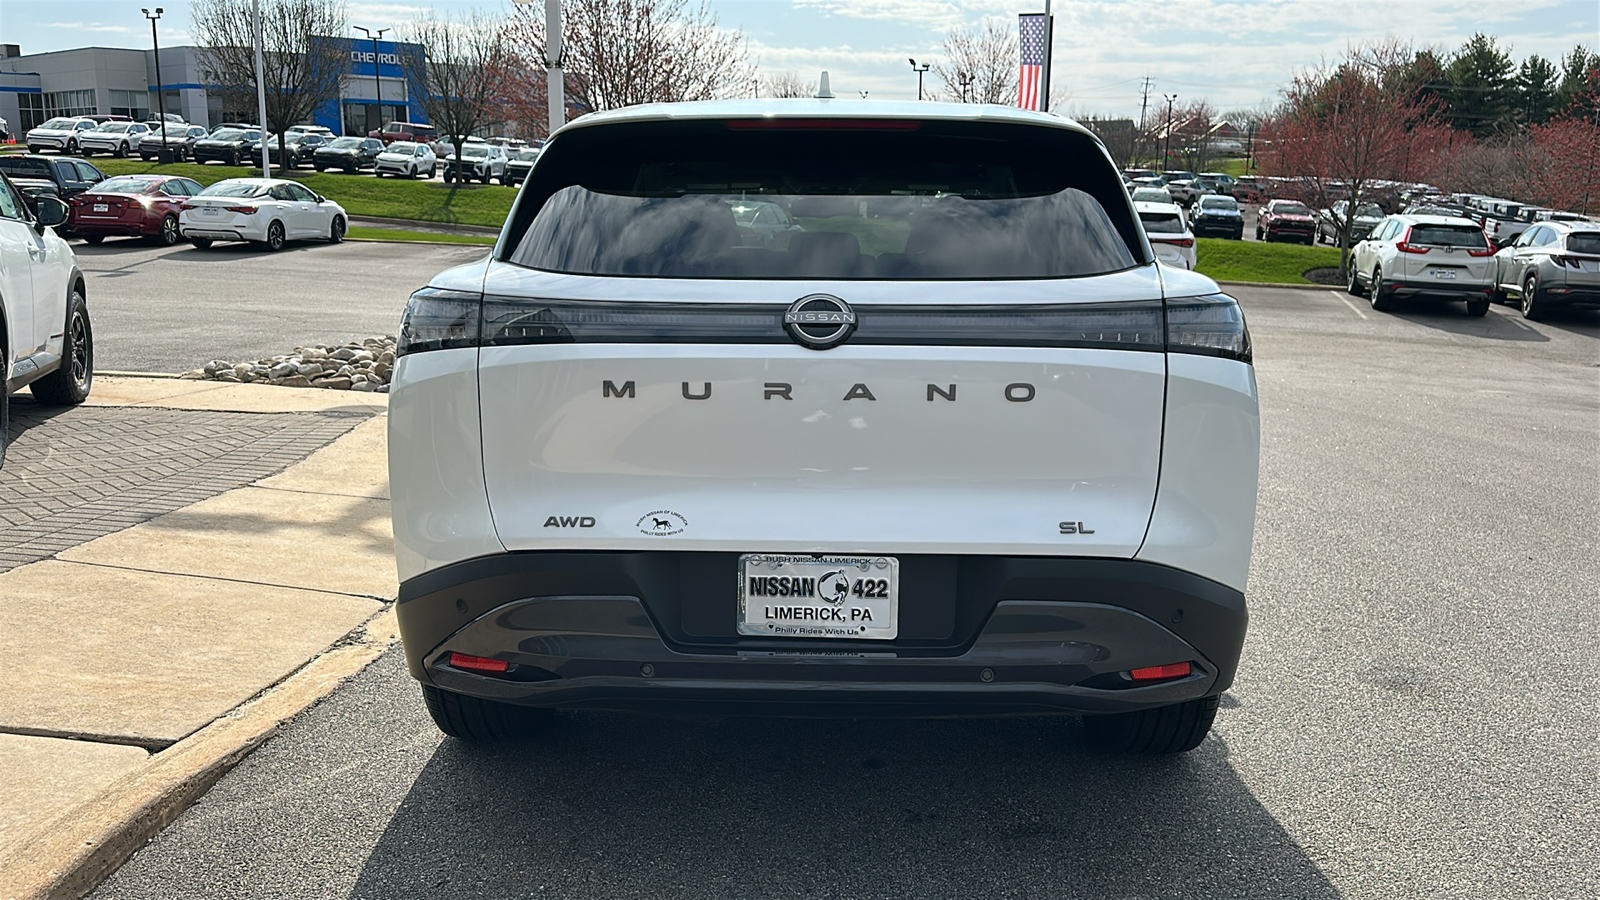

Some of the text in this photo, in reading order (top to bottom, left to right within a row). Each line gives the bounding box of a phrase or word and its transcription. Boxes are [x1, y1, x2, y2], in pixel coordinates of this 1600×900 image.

[351, 51, 411, 65] CHEVROL
[787, 313, 854, 322] NISSAN
[602, 380, 1036, 402] MURANO
[543, 516, 596, 528] AWD
[671, 511, 688, 526] LIMERICK
[1059, 521, 1095, 534] SL
[793, 556, 827, 564] NISSAN
[829, 557, 872, 565] LIMERICK
[750, 576, 888, 599] NISSAN 422
[765, 606, 873, 622] LIMERICK, PA
[775, 627, 798, 635] Philly
